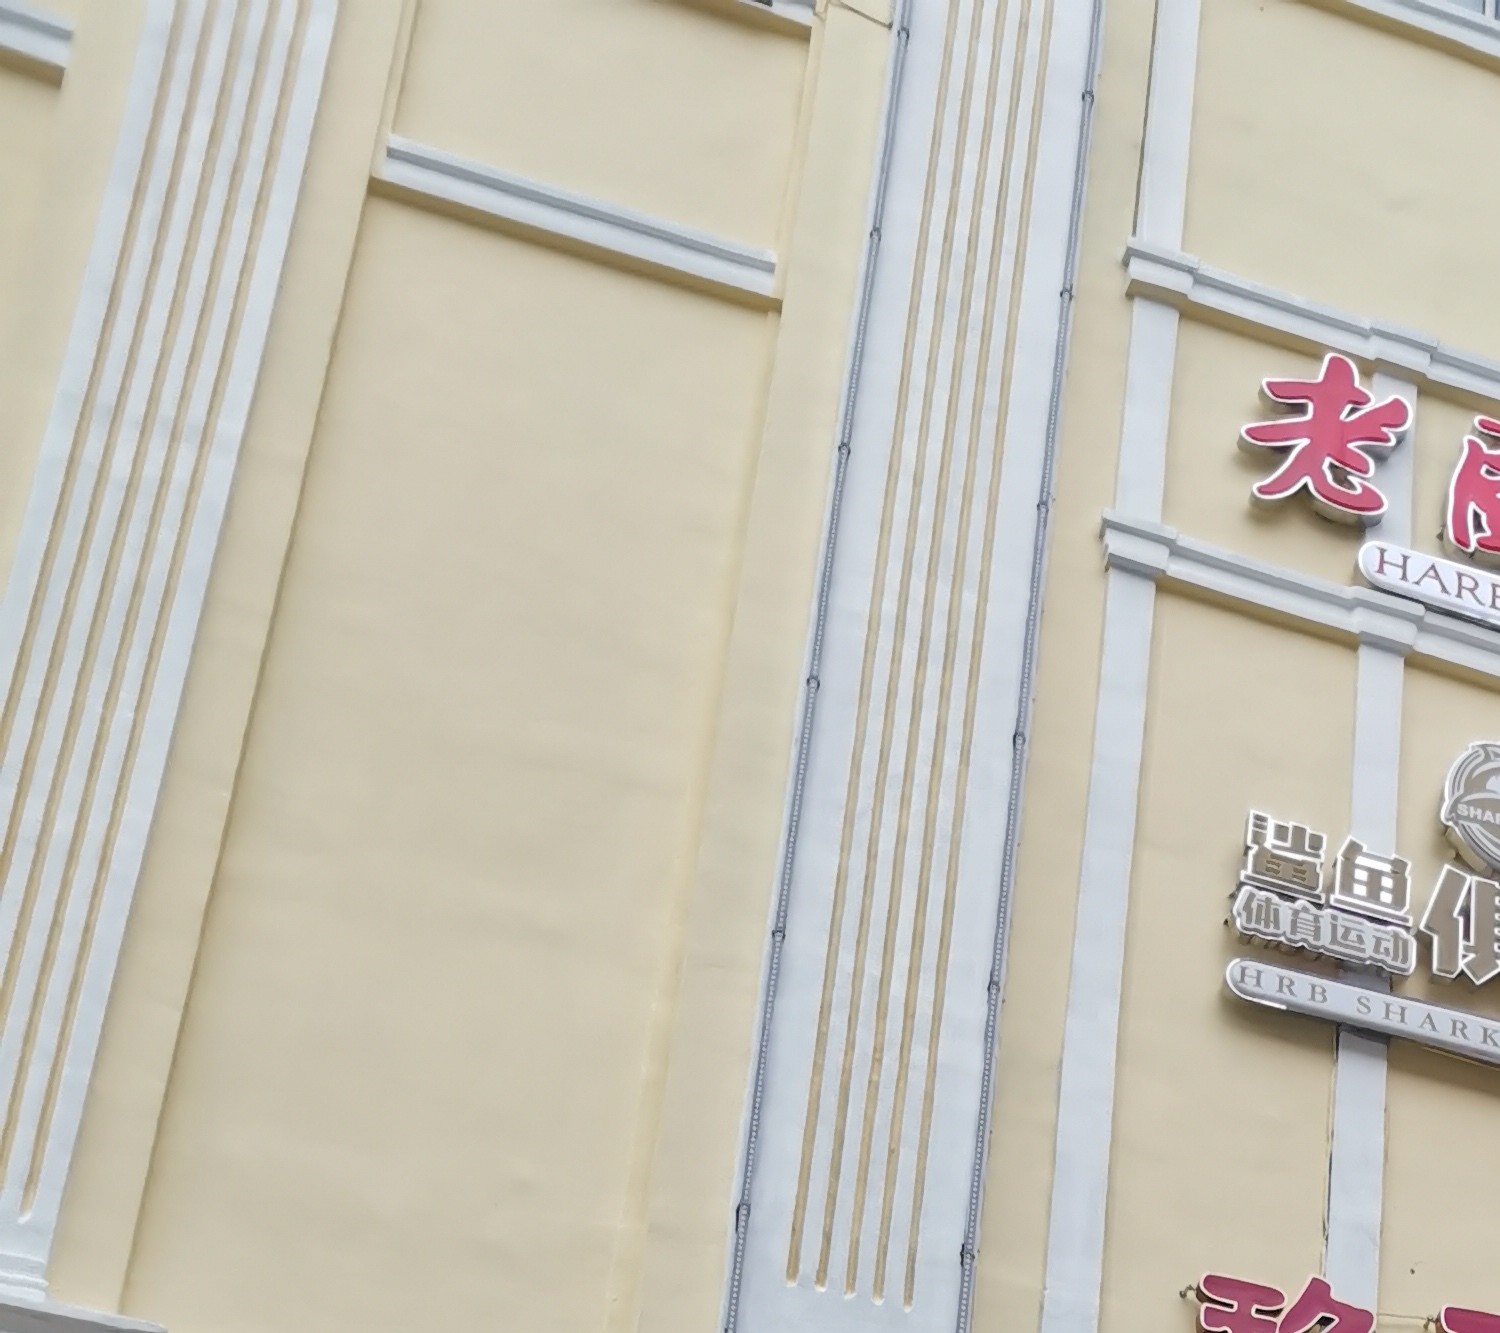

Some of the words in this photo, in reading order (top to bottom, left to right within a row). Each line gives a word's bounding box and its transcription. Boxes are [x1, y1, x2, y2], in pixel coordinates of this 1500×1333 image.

[1238, 810, 1412, 924] 鲨鱼
[1236, 890, 1416, 973] 体育运动
[1237, 965, 1330, 1006] HRB
